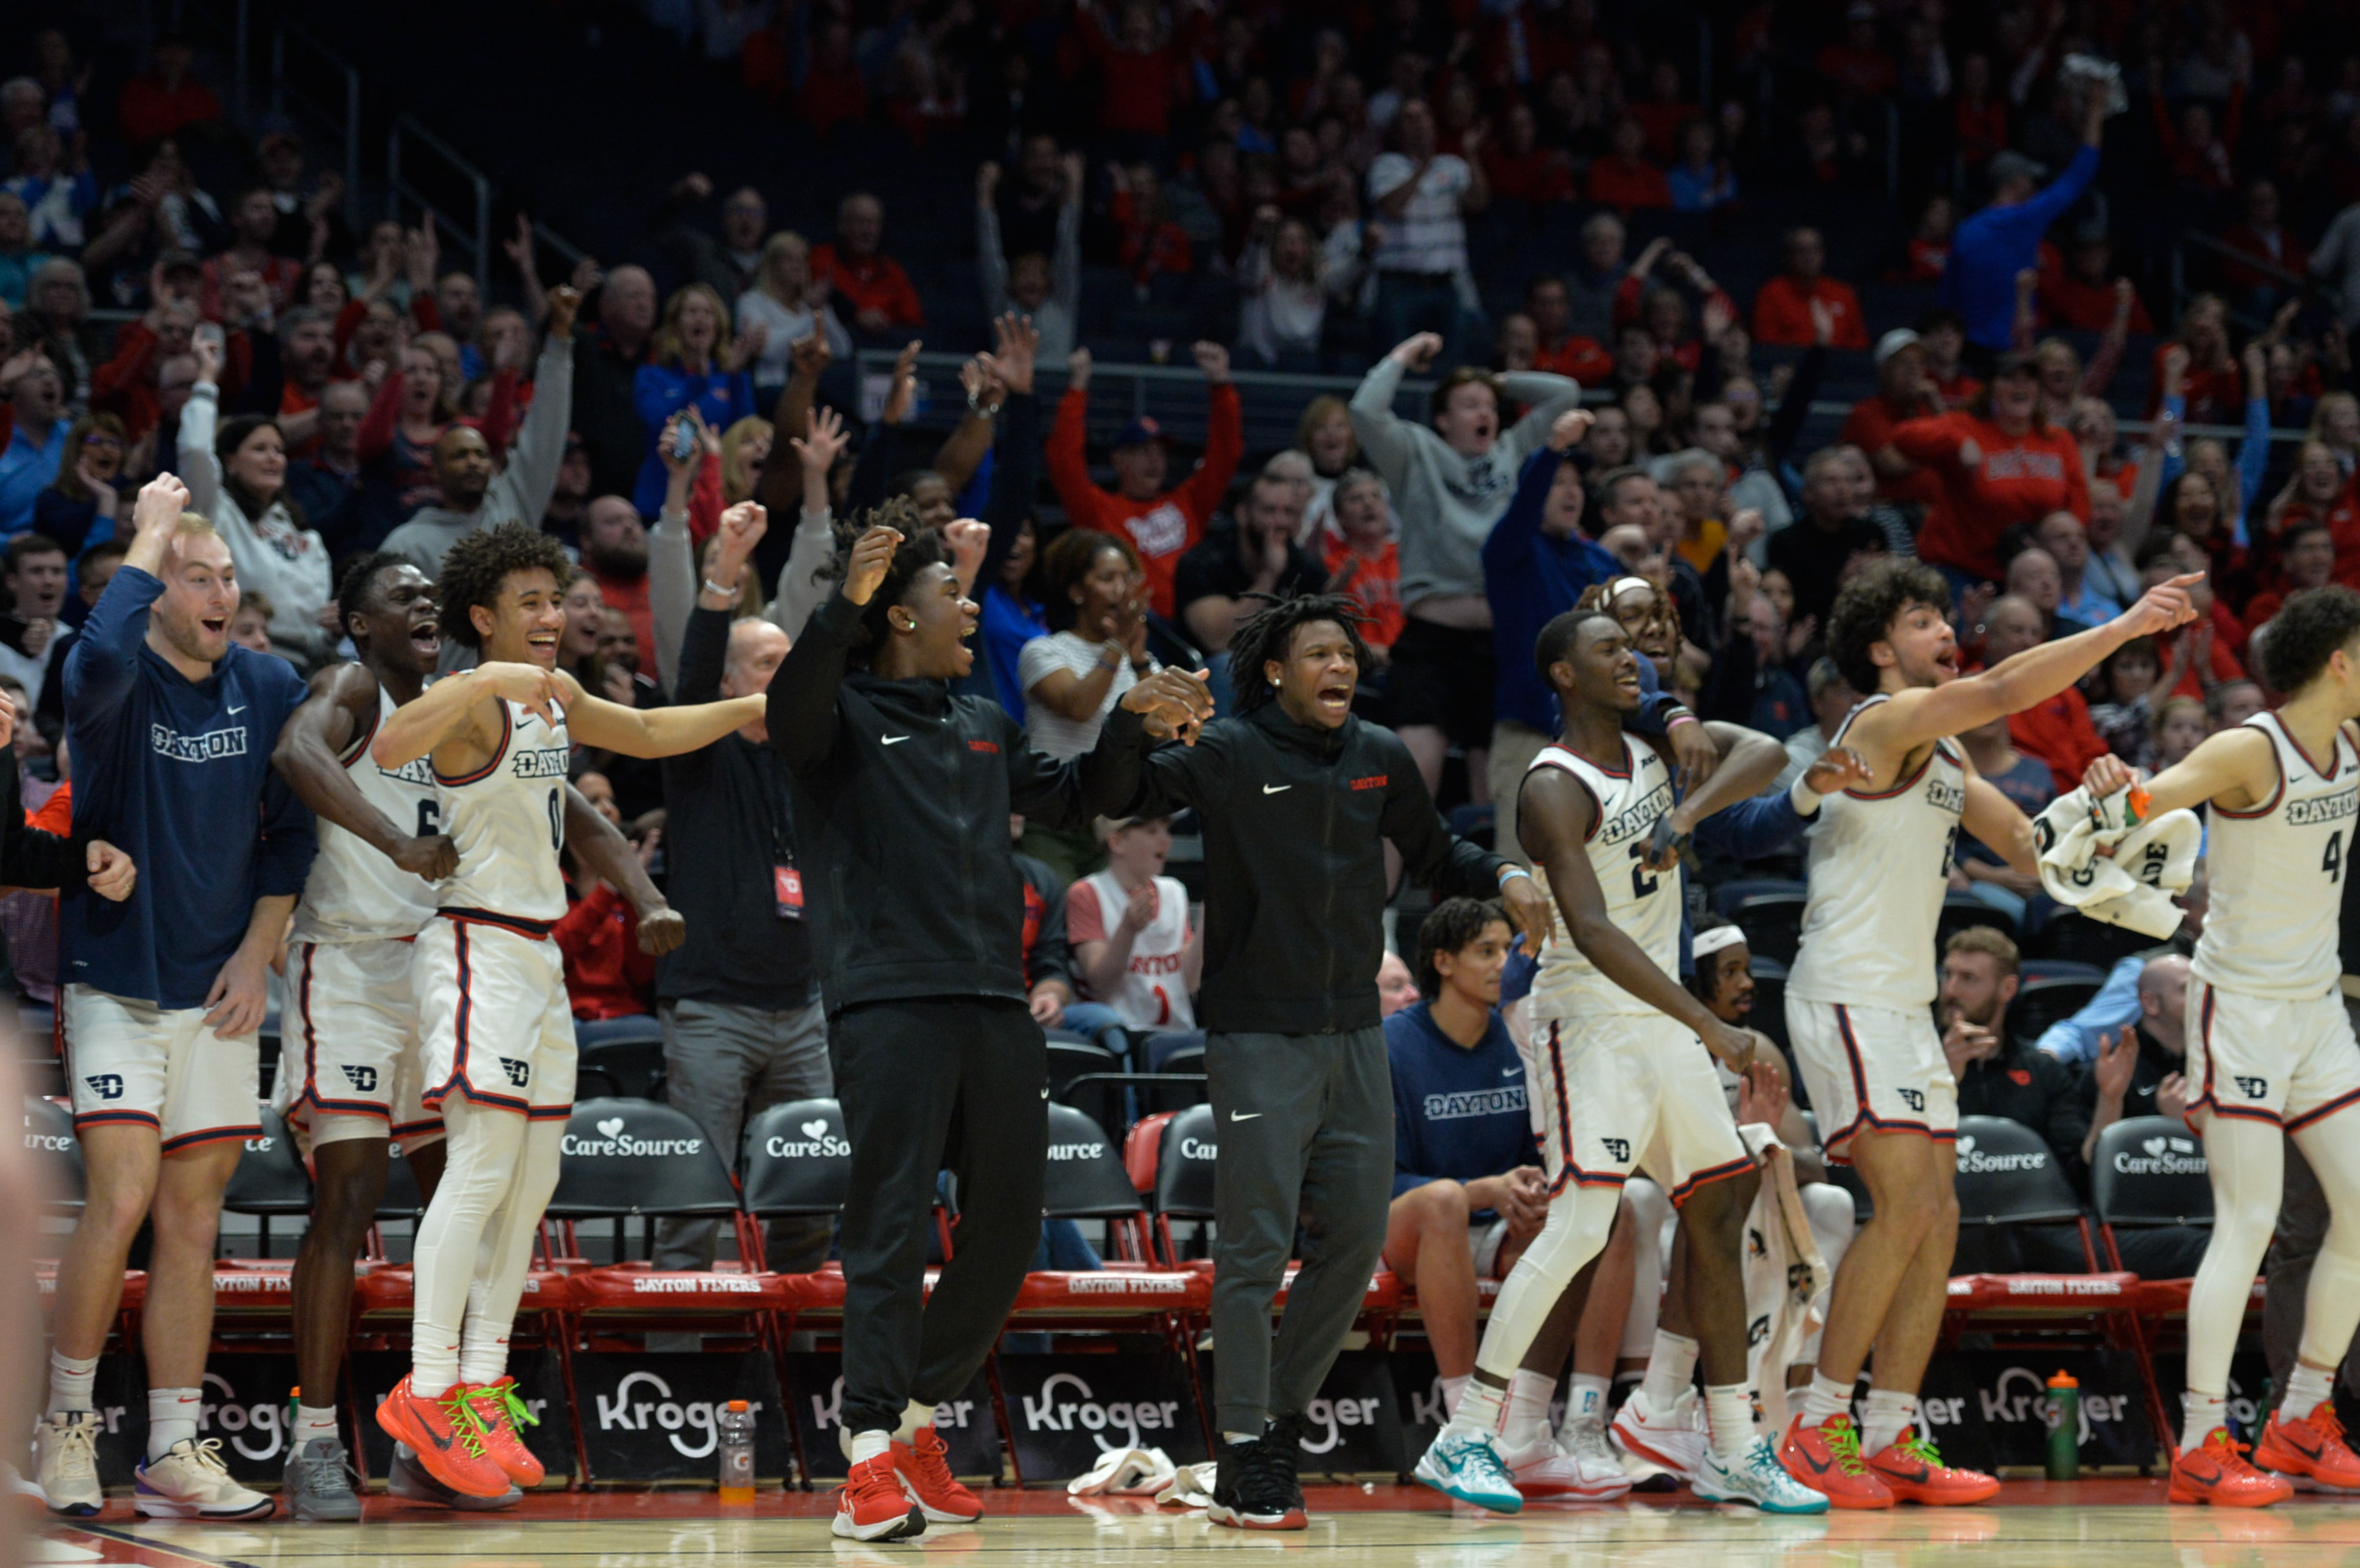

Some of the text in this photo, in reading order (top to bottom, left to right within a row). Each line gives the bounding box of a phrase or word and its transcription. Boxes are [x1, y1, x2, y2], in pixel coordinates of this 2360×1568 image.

[151, 723, 247, 762] DAYTON
[2321, 830, 2343, 884] 4
[1424, 1085, 1527, 1120] DAYTON
[561, 1135, 702, 1156] CareSource
[634, 1278, 761, 1293] DAYTON FLYERS
[1069, 1278, 1126, 1294] DAYTON
[1022, 1373, 1179, 1454] Kroger
